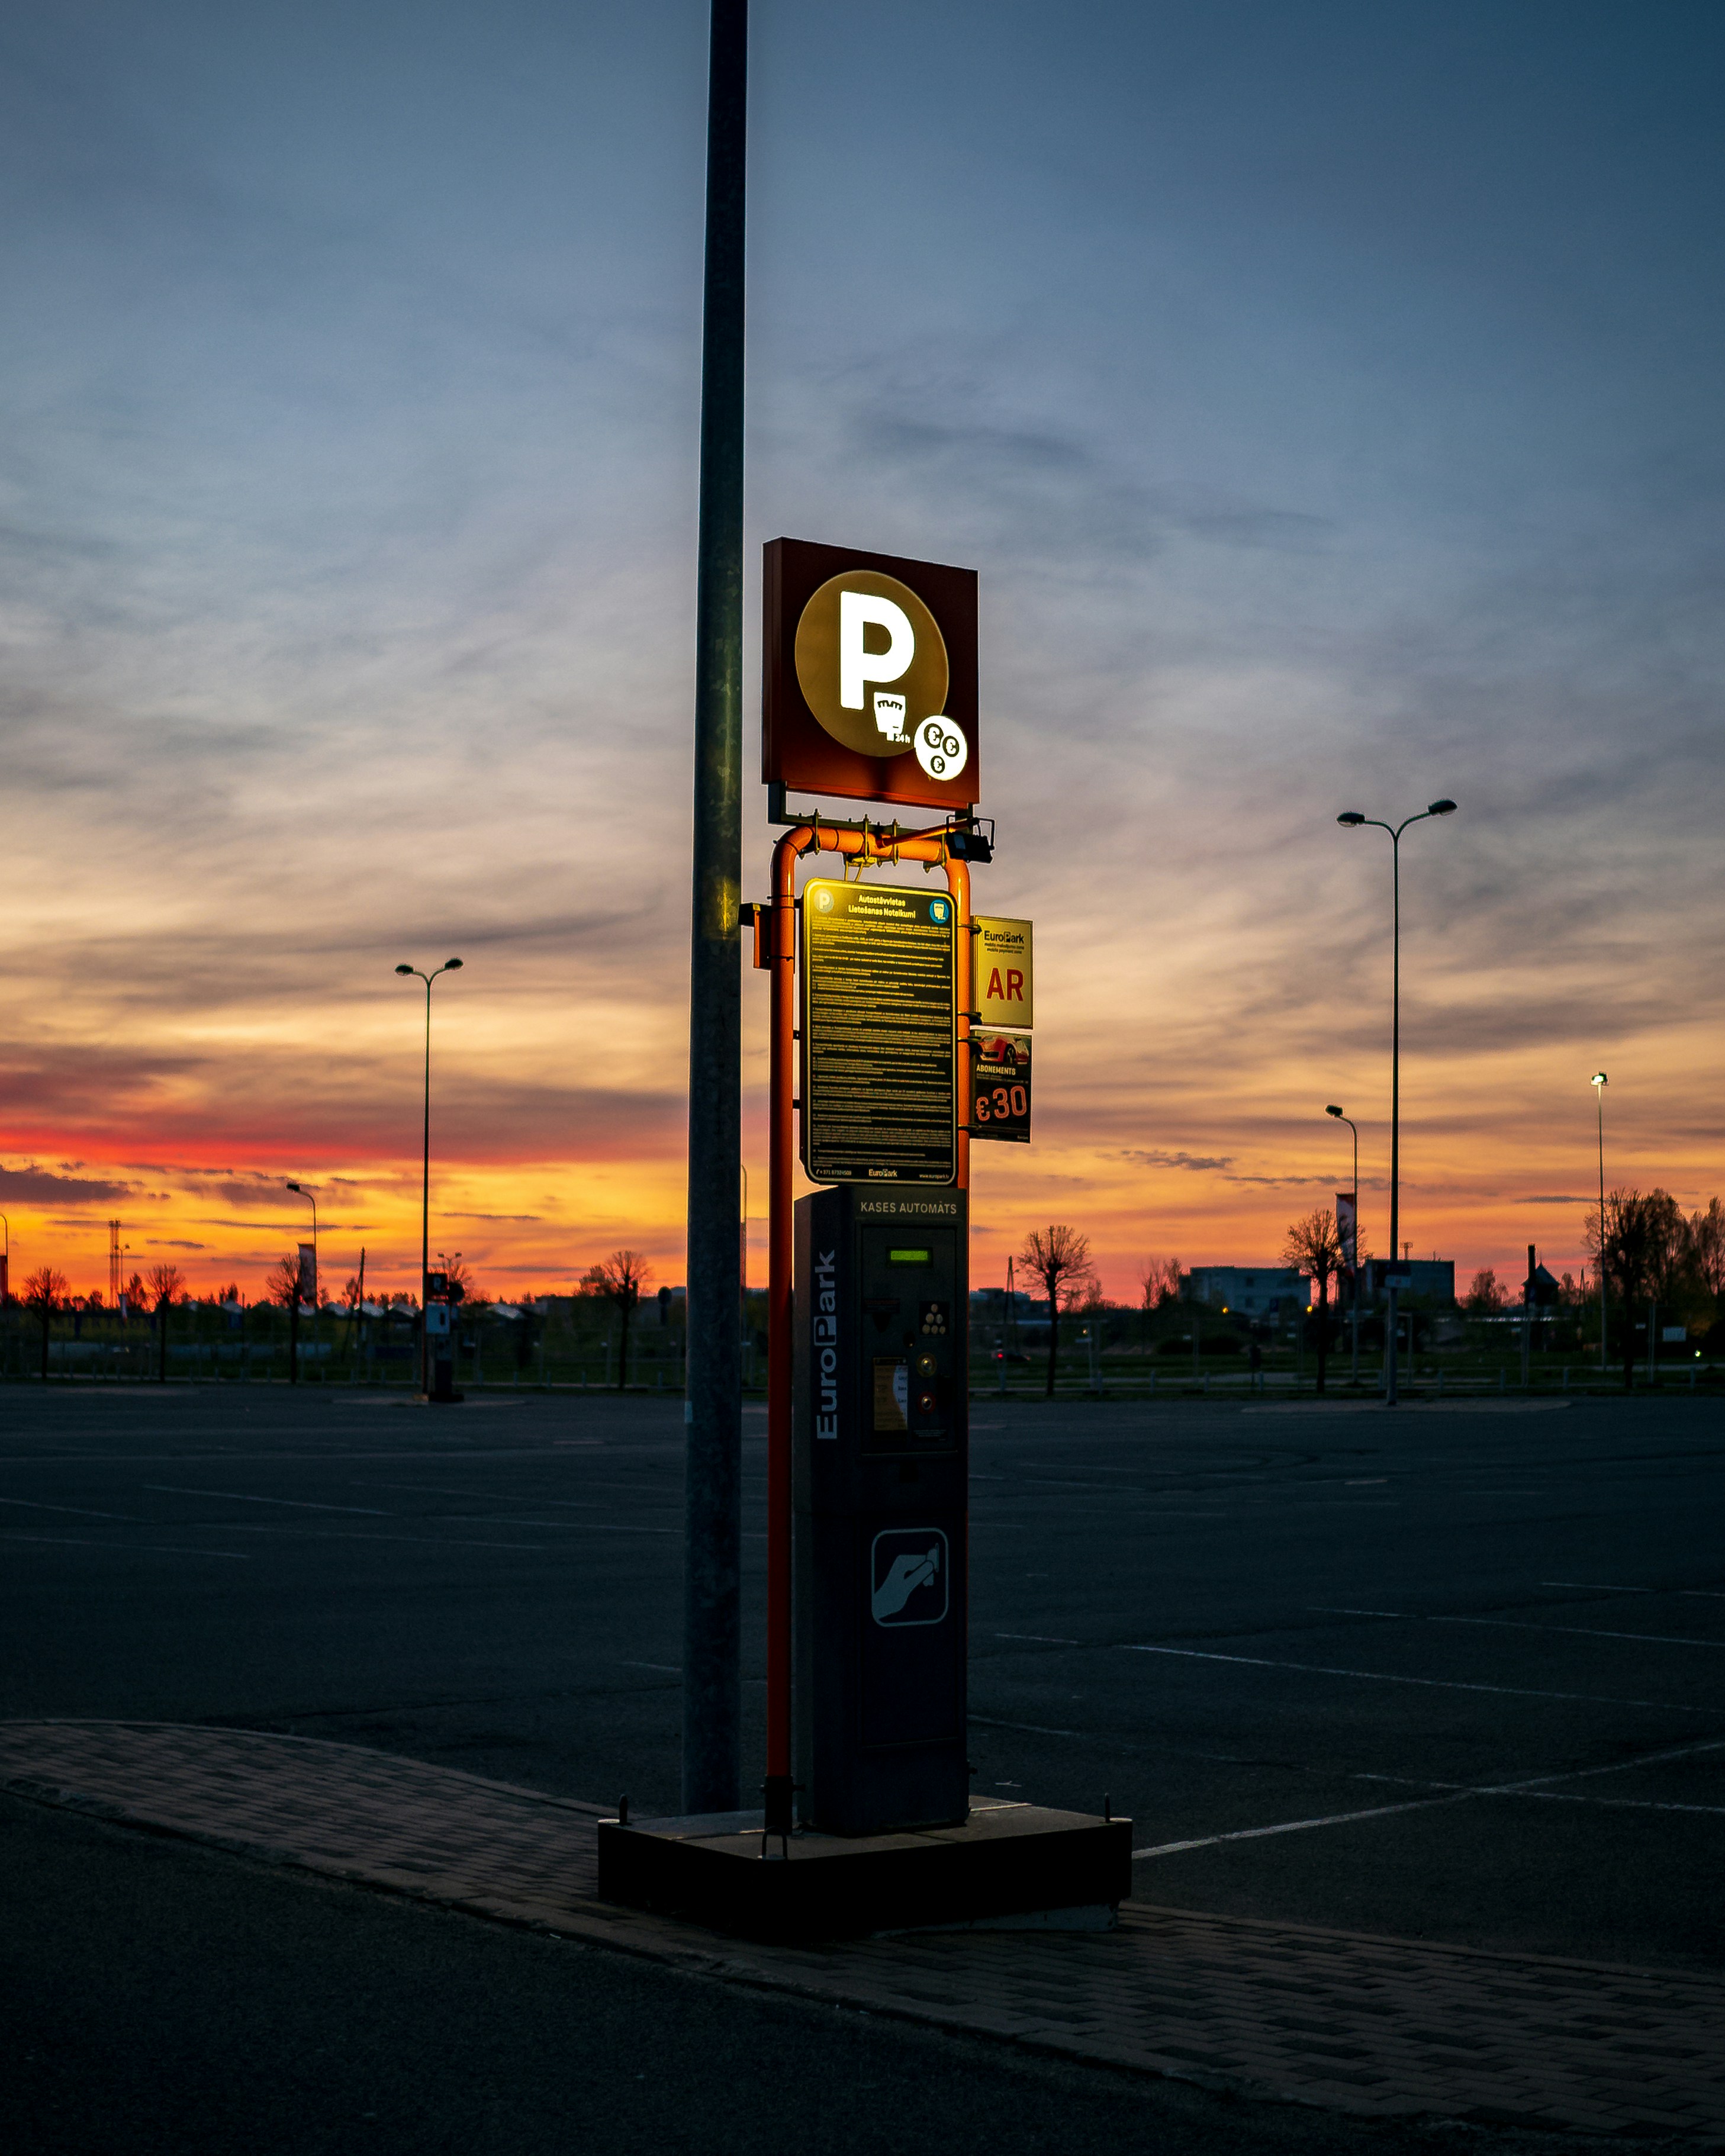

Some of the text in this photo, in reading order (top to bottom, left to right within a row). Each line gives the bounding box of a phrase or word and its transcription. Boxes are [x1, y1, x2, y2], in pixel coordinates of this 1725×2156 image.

[840, 591, 915, 710] P
[848, 905, 916, 919] Lietošanas Noteikumi
[984, 930, 1024, 944] EuroPark
[986, 967, 1024, 1002] AR
[976, 1064, 1016, 1075] ABONEMENTS
[868, 1168, 897, 1177] EuroPark
[861, 1201, 957, 1214] KASES AUTOMĀTS
[814, 1249, 838, 1440] EuroPark
